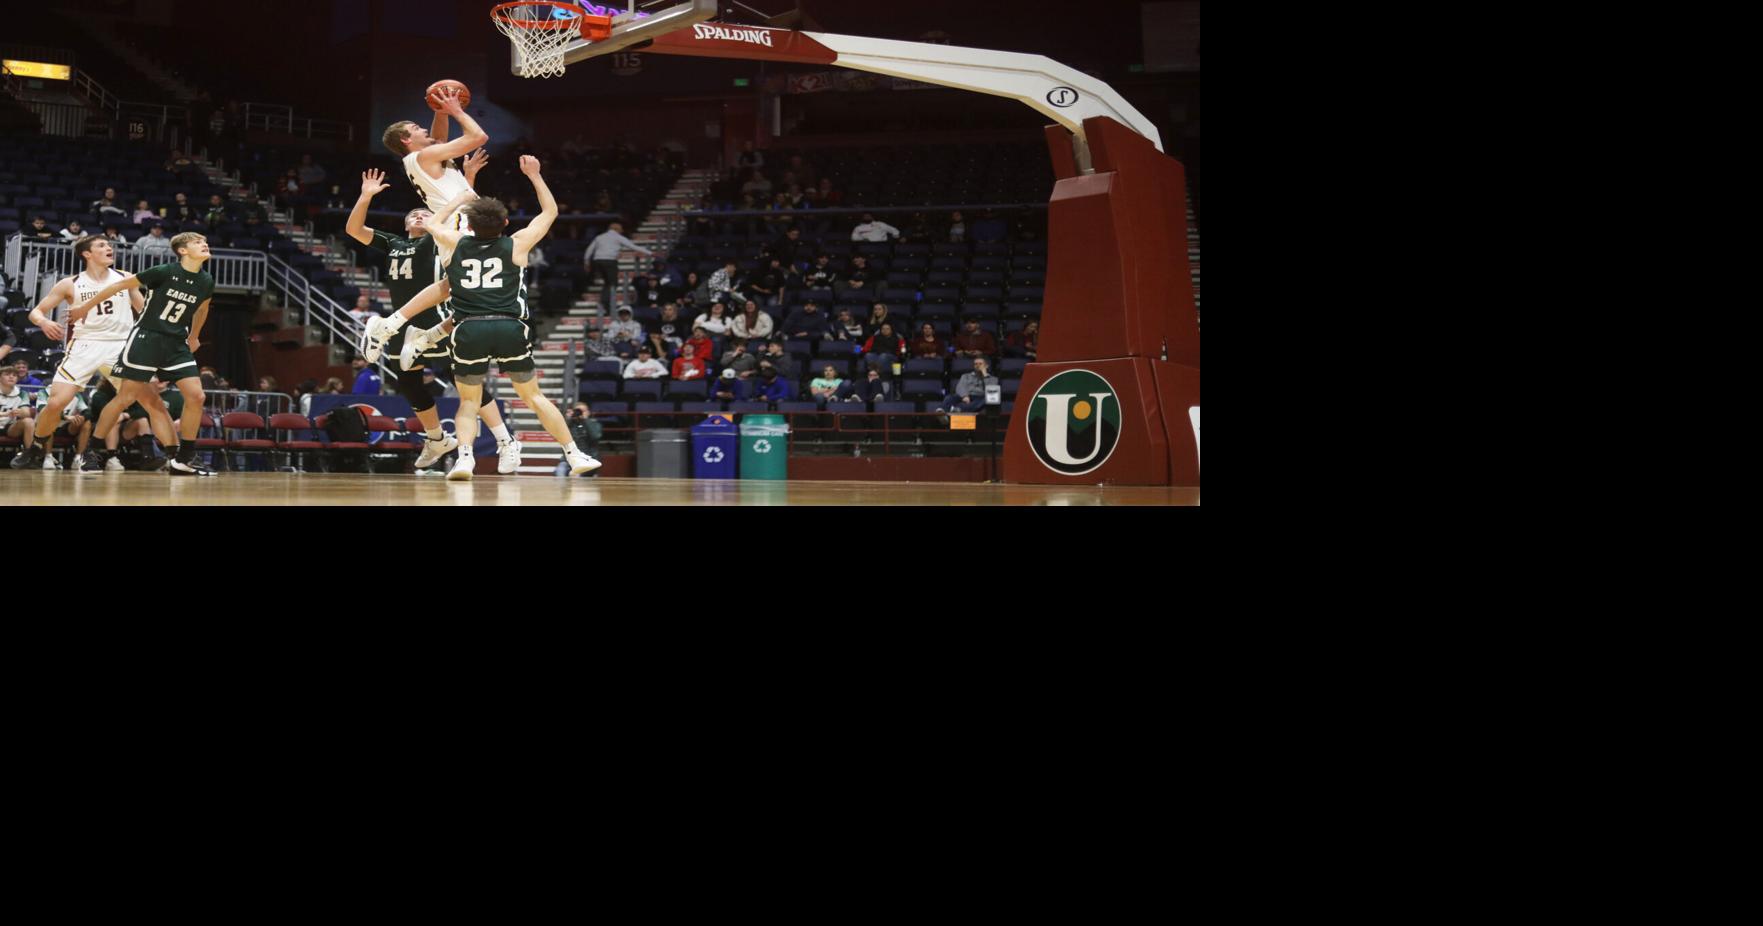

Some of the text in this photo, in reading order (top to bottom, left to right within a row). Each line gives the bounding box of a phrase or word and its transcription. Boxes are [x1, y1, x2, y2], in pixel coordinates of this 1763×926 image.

[693, 23, 773, 47] SPALDING
[613, 53, 640, 67] 115
[129, 123, 144, 133] 116
[388, 257, 413, 280] 44
[460, 257, 503, 288] 32
[97, 300, 113, 315] 12
[166, 288, 197, 304] EAGLES
[159, 300, 187, 324] 13
[1037, 392, 1112, 465] U
